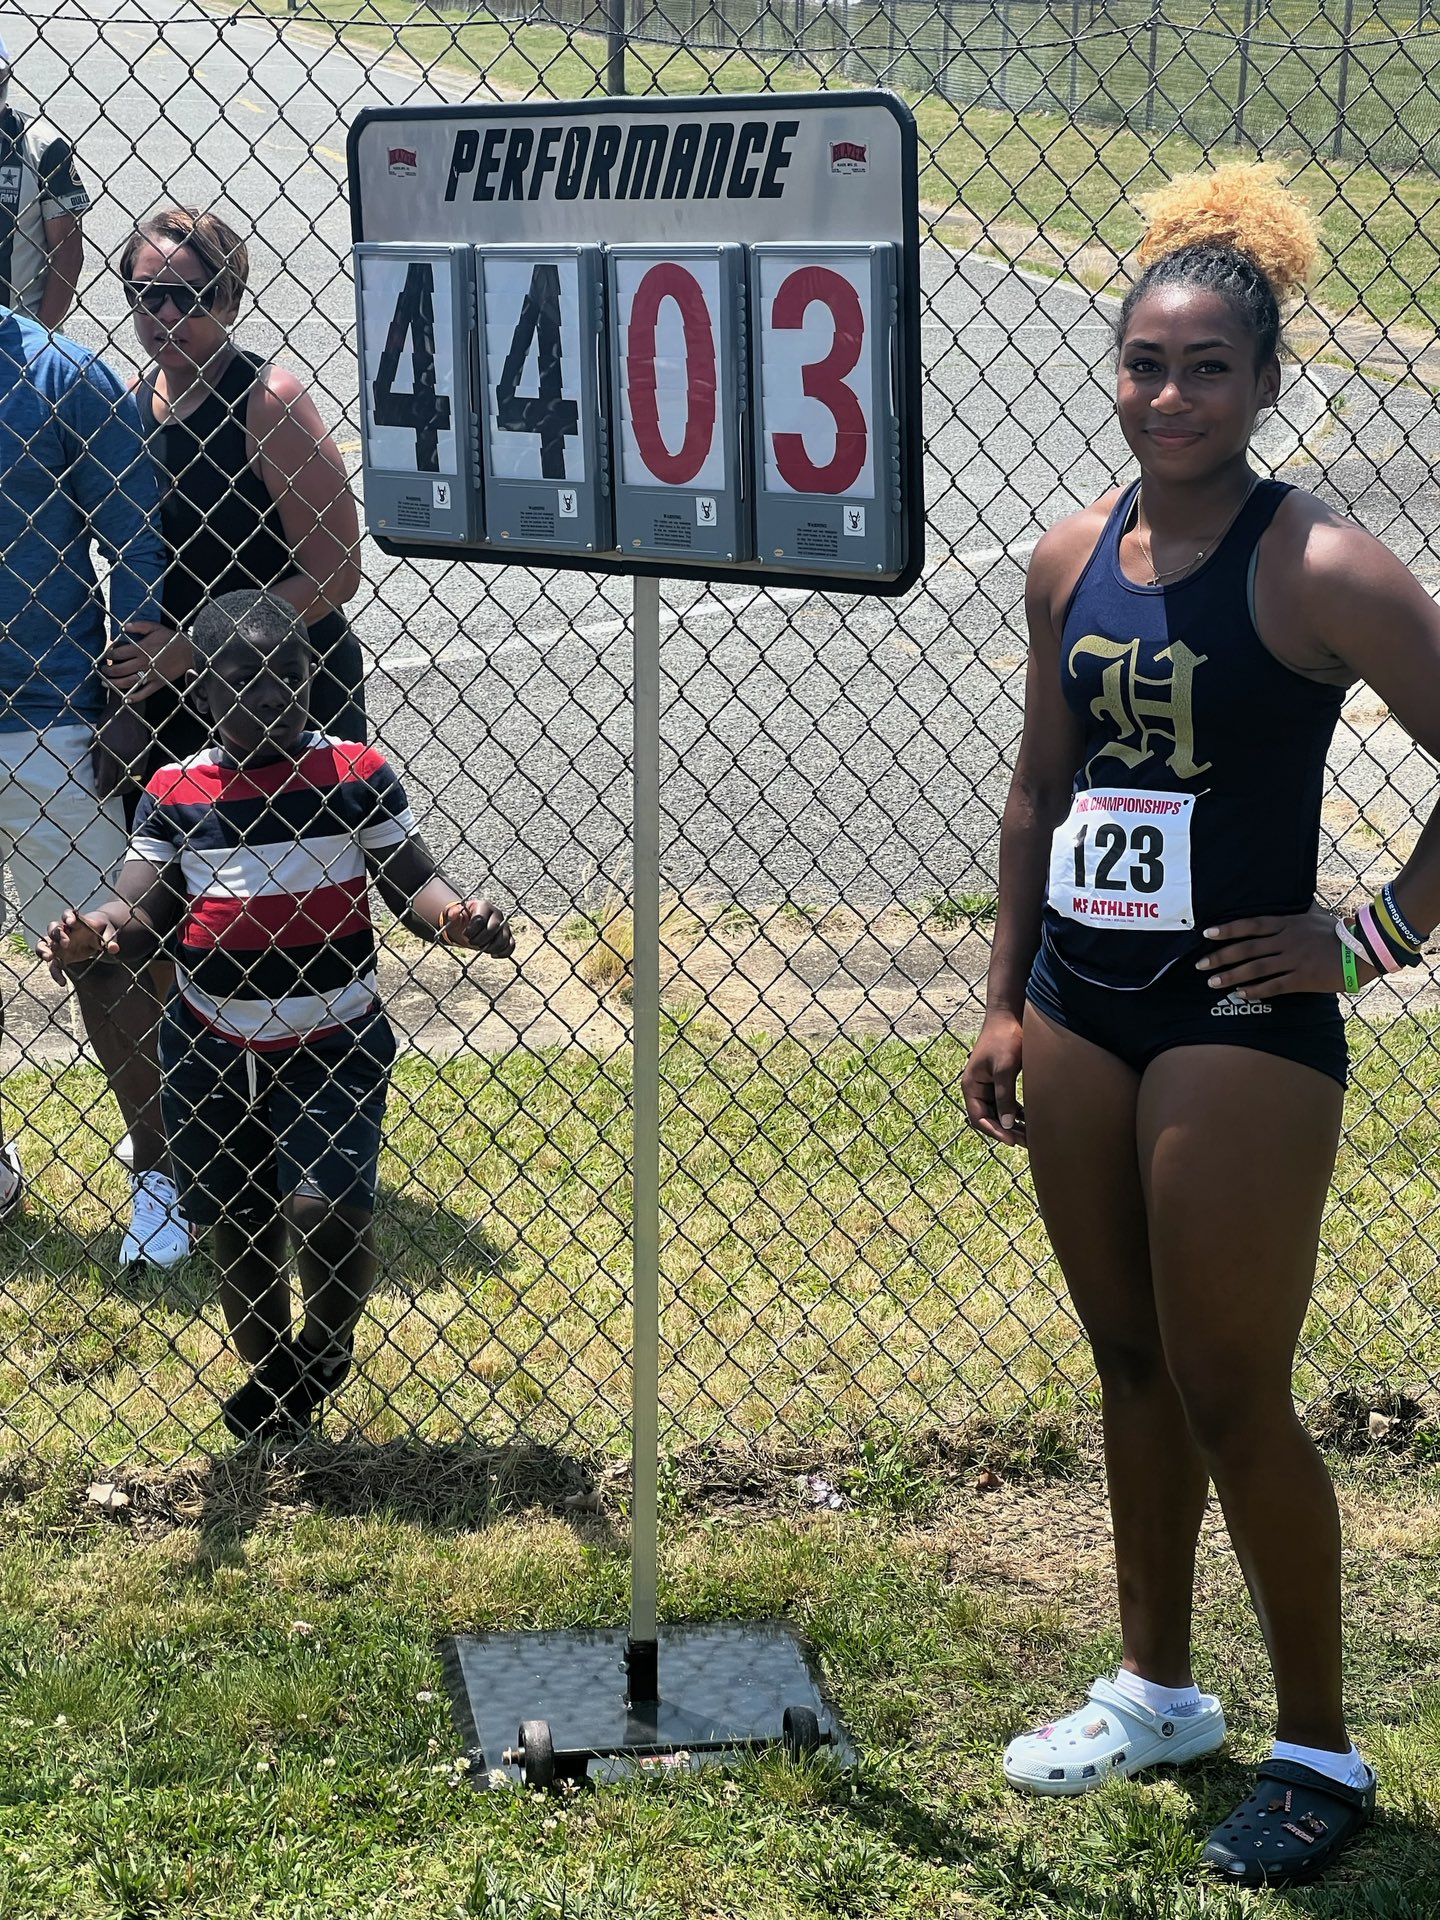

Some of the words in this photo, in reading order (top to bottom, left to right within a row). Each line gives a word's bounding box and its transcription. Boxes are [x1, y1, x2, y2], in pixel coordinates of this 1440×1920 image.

[445, 120, 800, 202] PERFORMANCE
[1090, 796, 1181, 815] CHAMPIONSHIPS
[1073, 823, 1164, 894] 123
[1090, 899, 1159, 918] ATHLETIC
[1210, 1002, 1272, 1016] adidas
